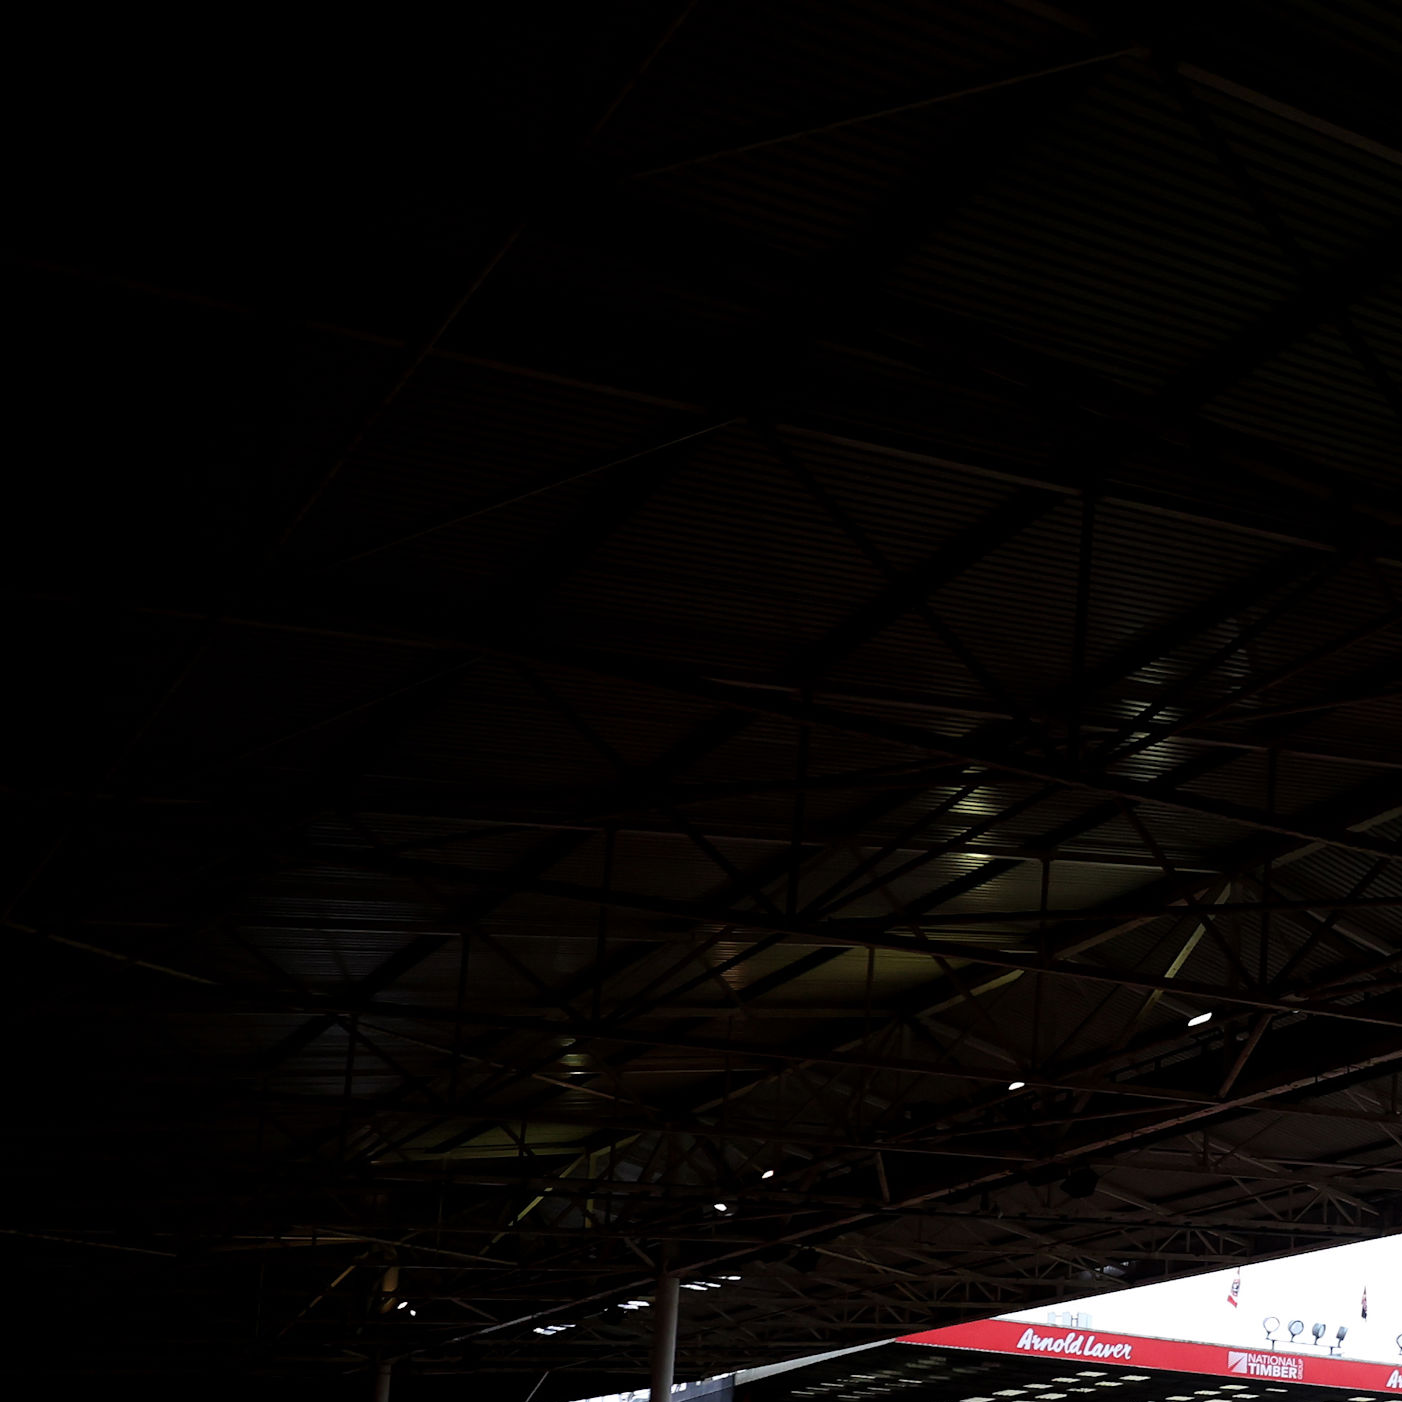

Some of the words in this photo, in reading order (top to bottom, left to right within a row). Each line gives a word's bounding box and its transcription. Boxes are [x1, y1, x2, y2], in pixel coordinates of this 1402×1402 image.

[1017, 1328, 1082, 1355] Arnold
[1083, 1336, 1132, 1359] Laver
[1248, 1353, 1298, 1367] NATIONAL
[1248, 1363, 1298, 1379] TIMBER
